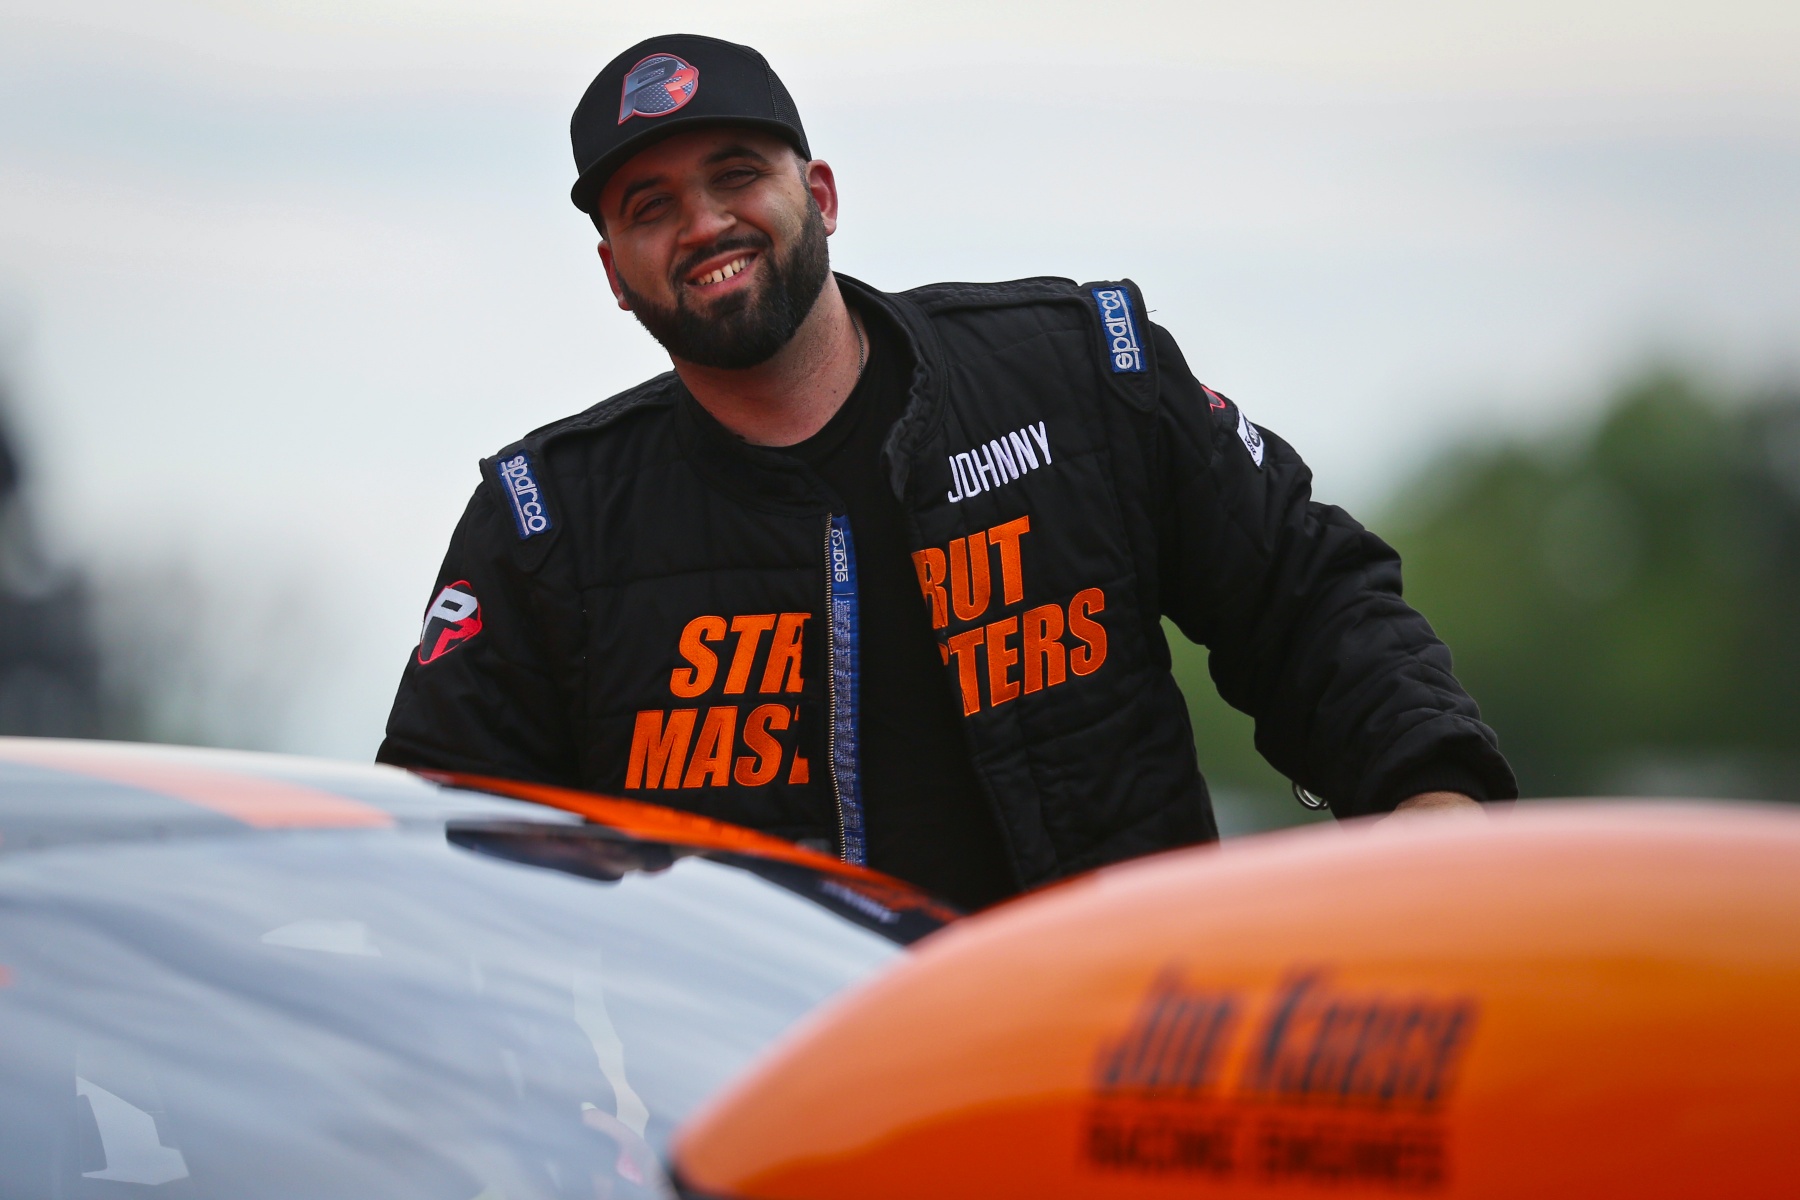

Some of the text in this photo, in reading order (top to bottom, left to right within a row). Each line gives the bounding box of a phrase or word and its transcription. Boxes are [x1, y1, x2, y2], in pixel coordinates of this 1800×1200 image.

[1098, 289, 1140, 370] sparco
[502, 455, 547, 535] sparco
[947, 421, 1052, 503] JOHNNY
[831, 528, 848, 582] sparco
[911, 515, 1030, 630] RUT
[938, 587, 1107, 717] TERS
